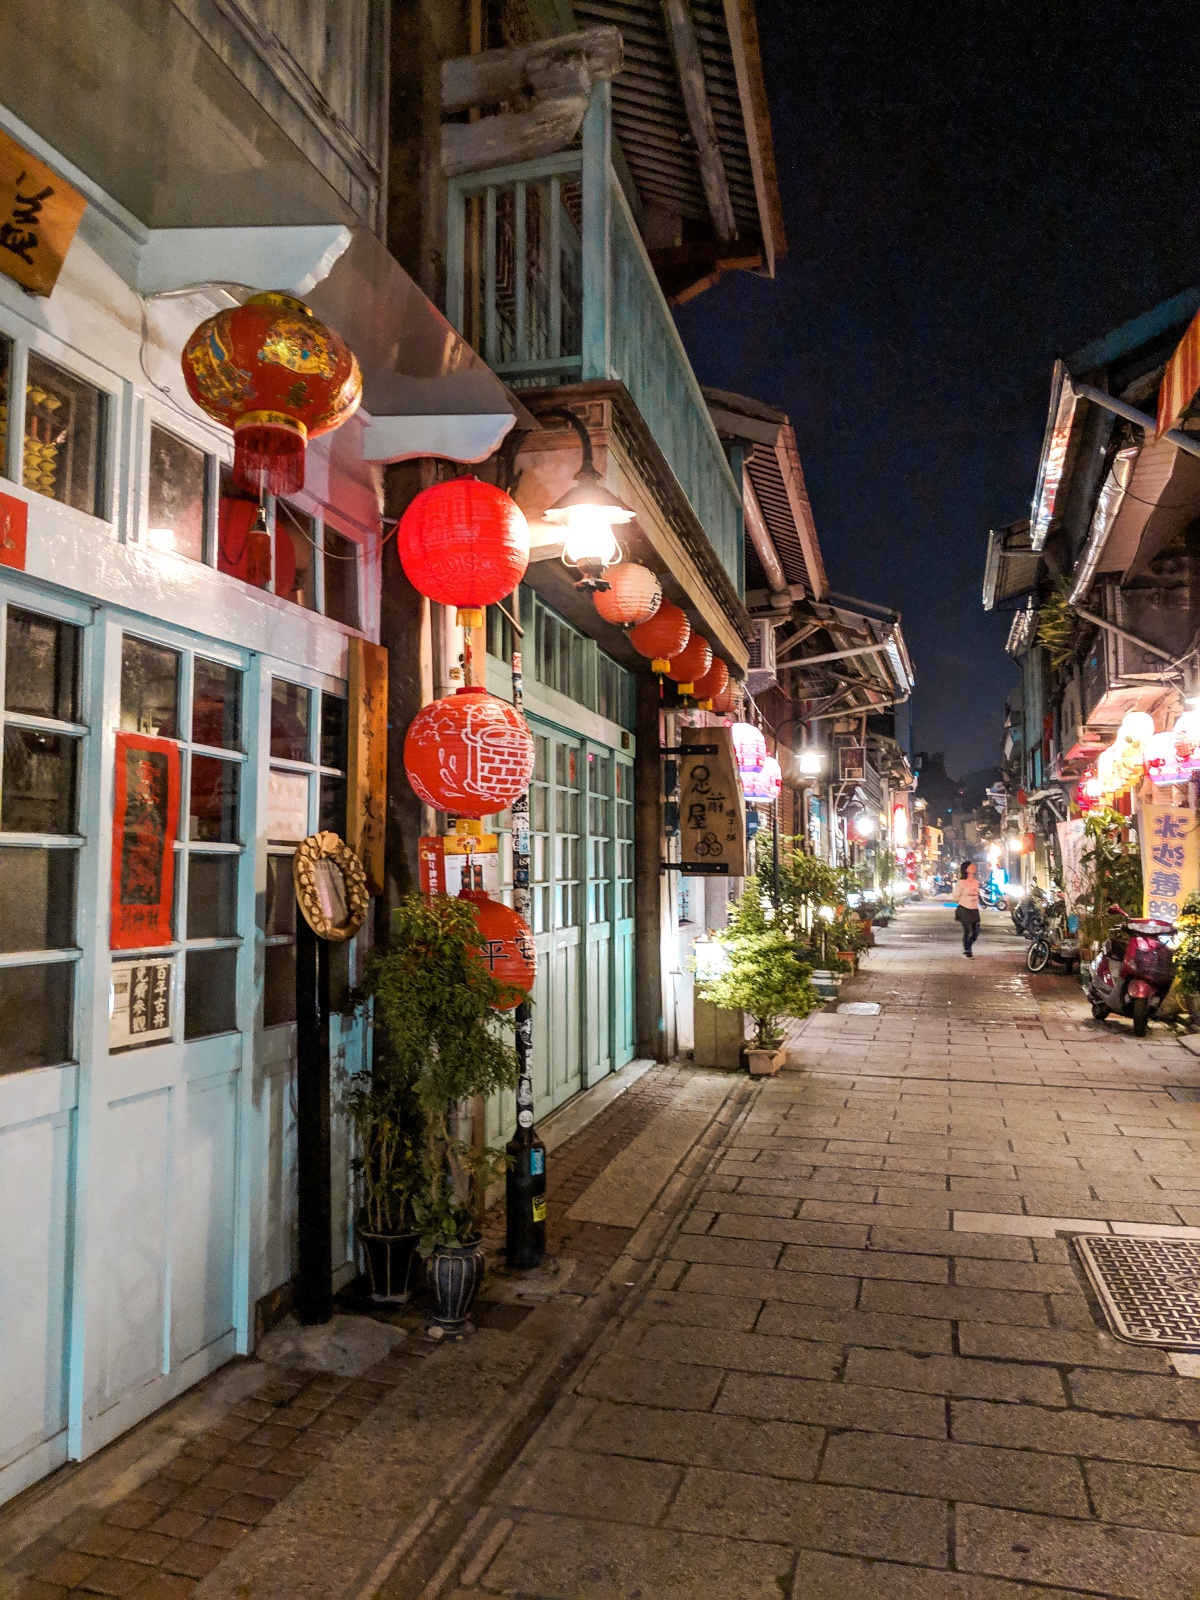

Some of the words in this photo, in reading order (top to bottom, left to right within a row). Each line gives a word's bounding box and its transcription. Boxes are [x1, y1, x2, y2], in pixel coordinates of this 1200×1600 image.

[480, 930, 537, 971] 平安
[133, 966, 148, 1032] 免費參觀
[154, 964, 168, 1028] 百年古井
